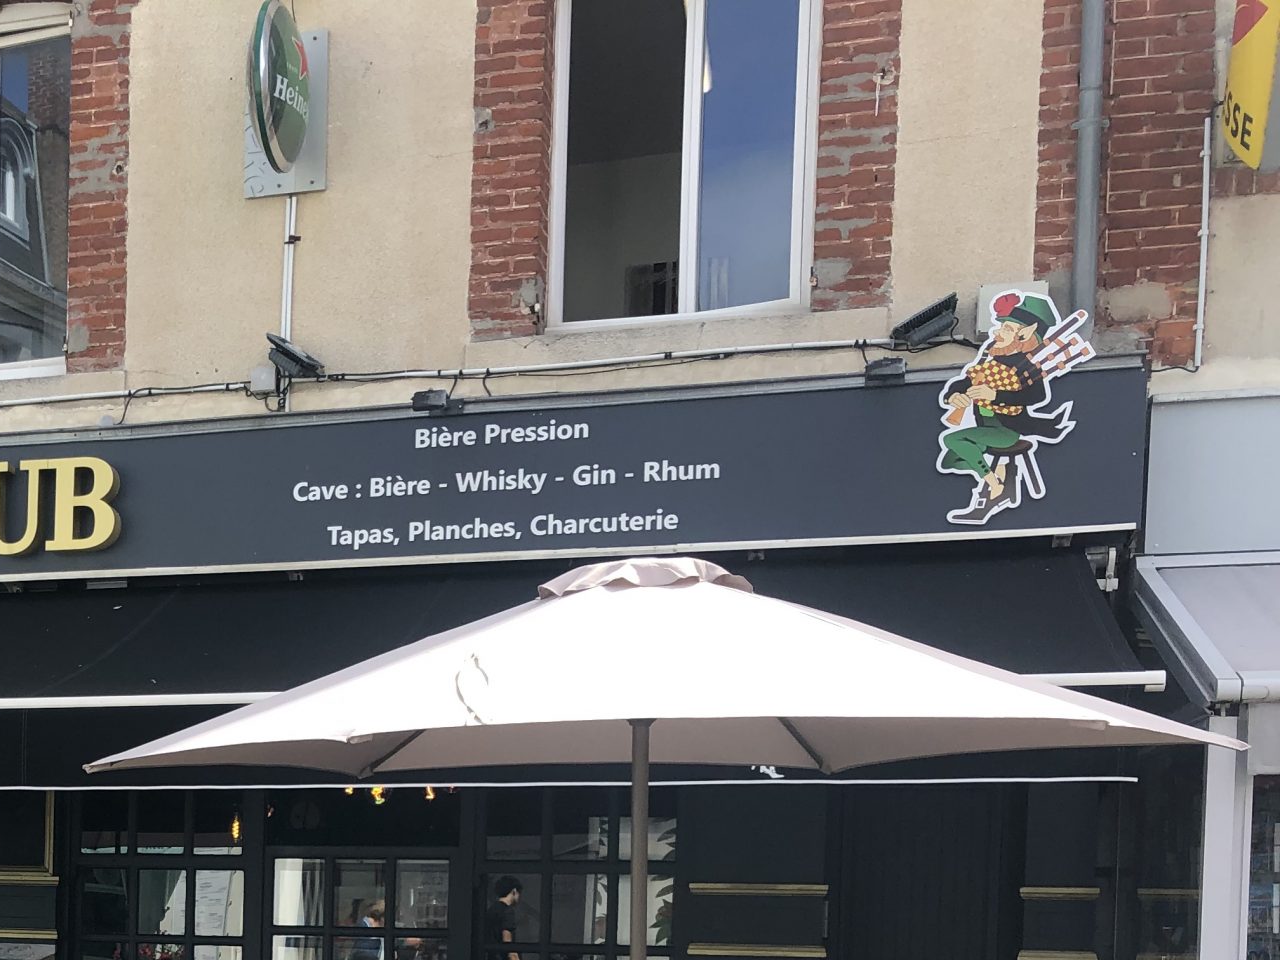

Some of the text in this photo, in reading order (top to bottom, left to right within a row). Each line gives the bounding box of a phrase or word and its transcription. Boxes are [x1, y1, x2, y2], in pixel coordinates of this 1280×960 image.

[1223, 82, 1253, 151] SSE
[414, 420, 590, 449] Bière Pression
[292, 481, 349, 502] Cave
[369, 475, 431, 498] Bière
[456, 468, 547, 495] Whisky
[572, 464, 616, 486] Gin
[643, 460, 720, 482] Rhum
[327, 508, 679, 550] Tapas, Planches, Charcuterie
